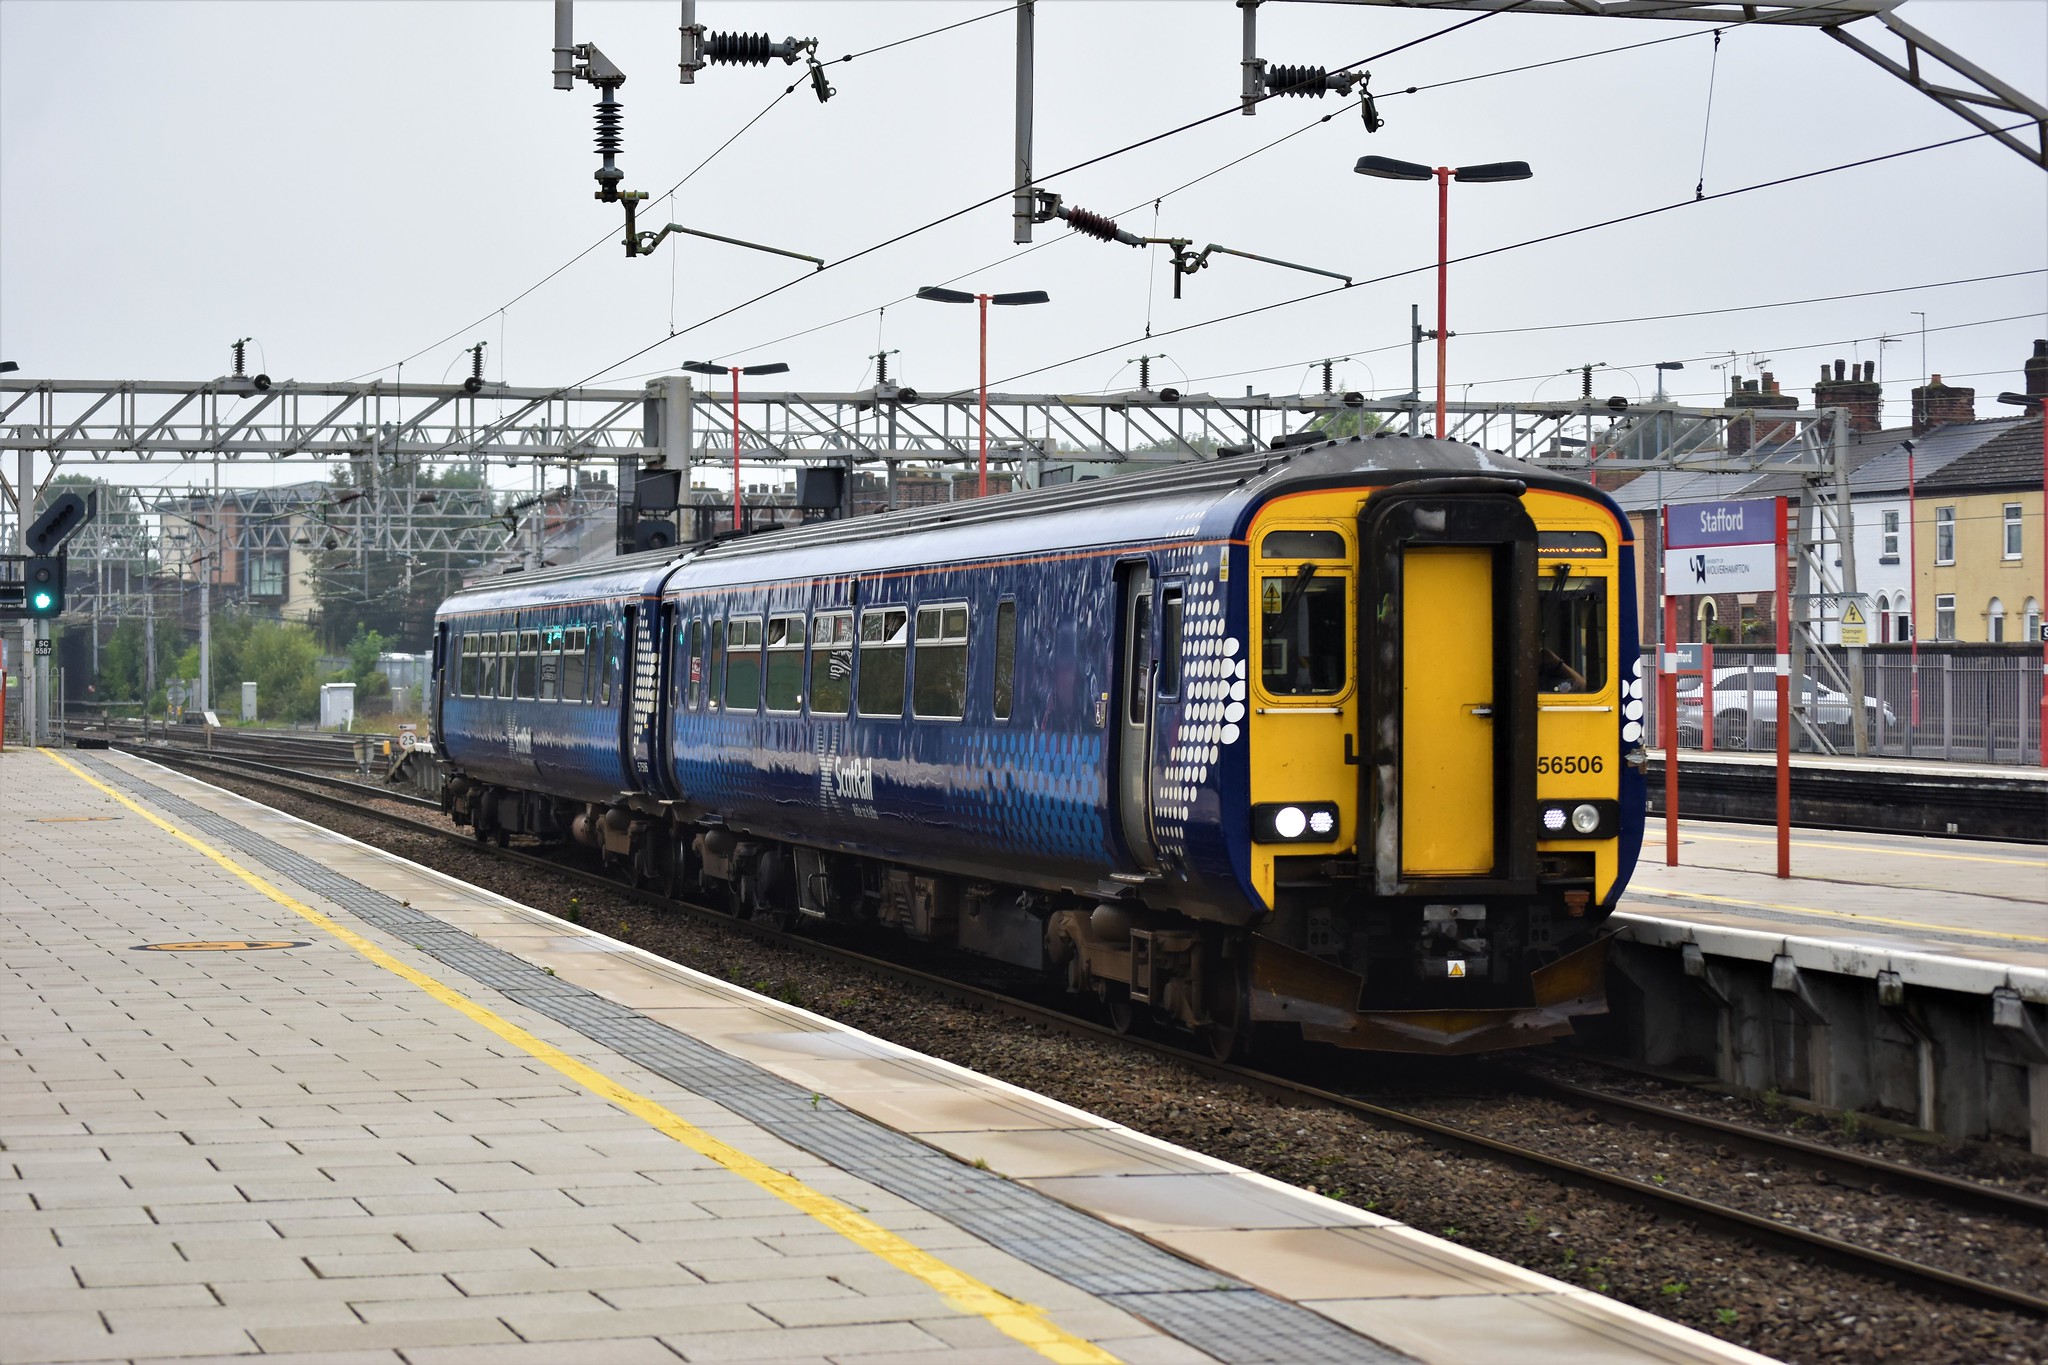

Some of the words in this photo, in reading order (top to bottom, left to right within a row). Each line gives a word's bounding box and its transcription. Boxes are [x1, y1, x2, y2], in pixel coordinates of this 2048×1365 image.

[1700, 506, 1743, 532] Stafford
[1706, 563, 1750, 575] WOLVERHAMPTON
[1841, 627, 1863, 635] Danger
[35, 647, 52, 655] 5587
[402, 735, 415, 746] 25
[1537, 755, 1603, 775] 56506
[835, 755, 874, 801] ScotRail
